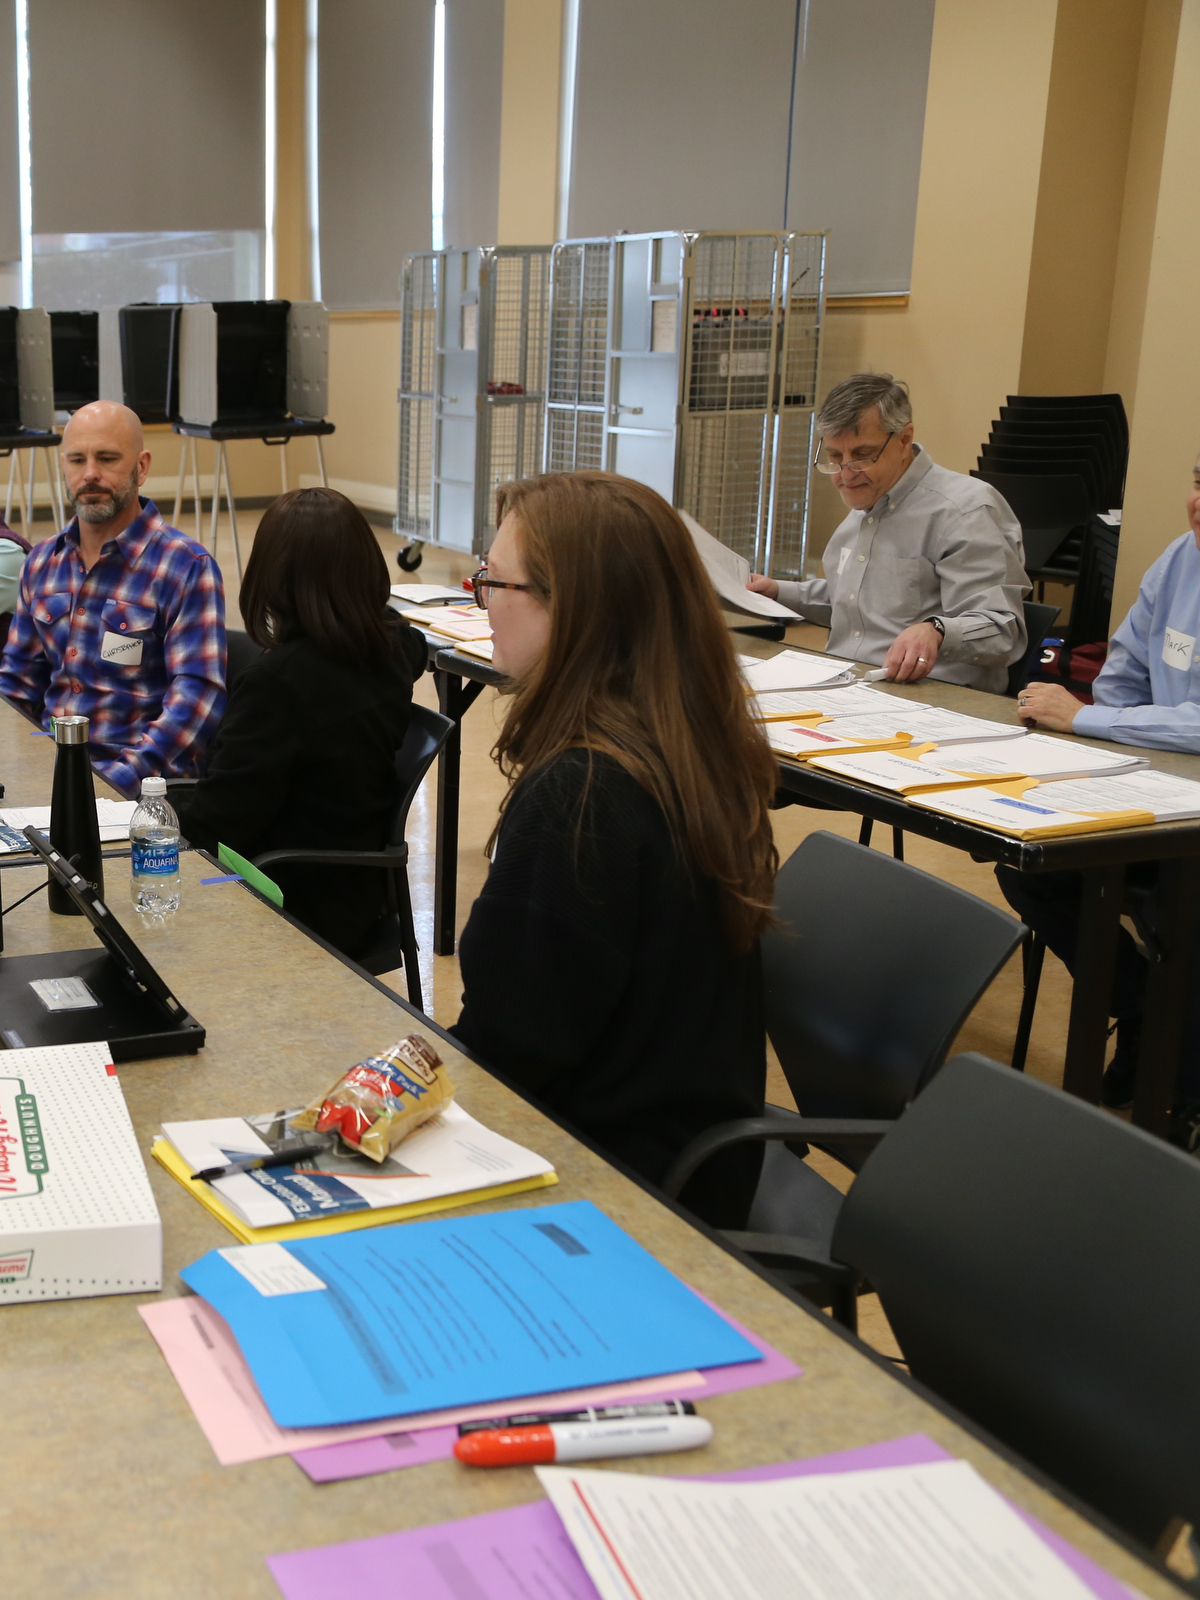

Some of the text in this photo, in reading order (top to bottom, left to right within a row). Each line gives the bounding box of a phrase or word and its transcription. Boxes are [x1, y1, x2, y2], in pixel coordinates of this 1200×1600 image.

[142, 854, 179, 870] AQUAFINA
[18, 1096, 46, 1171] DOUGHNUTS
[271, 1182, 312, 1214] Election
[282, 1173, 341, 1210] Manual
